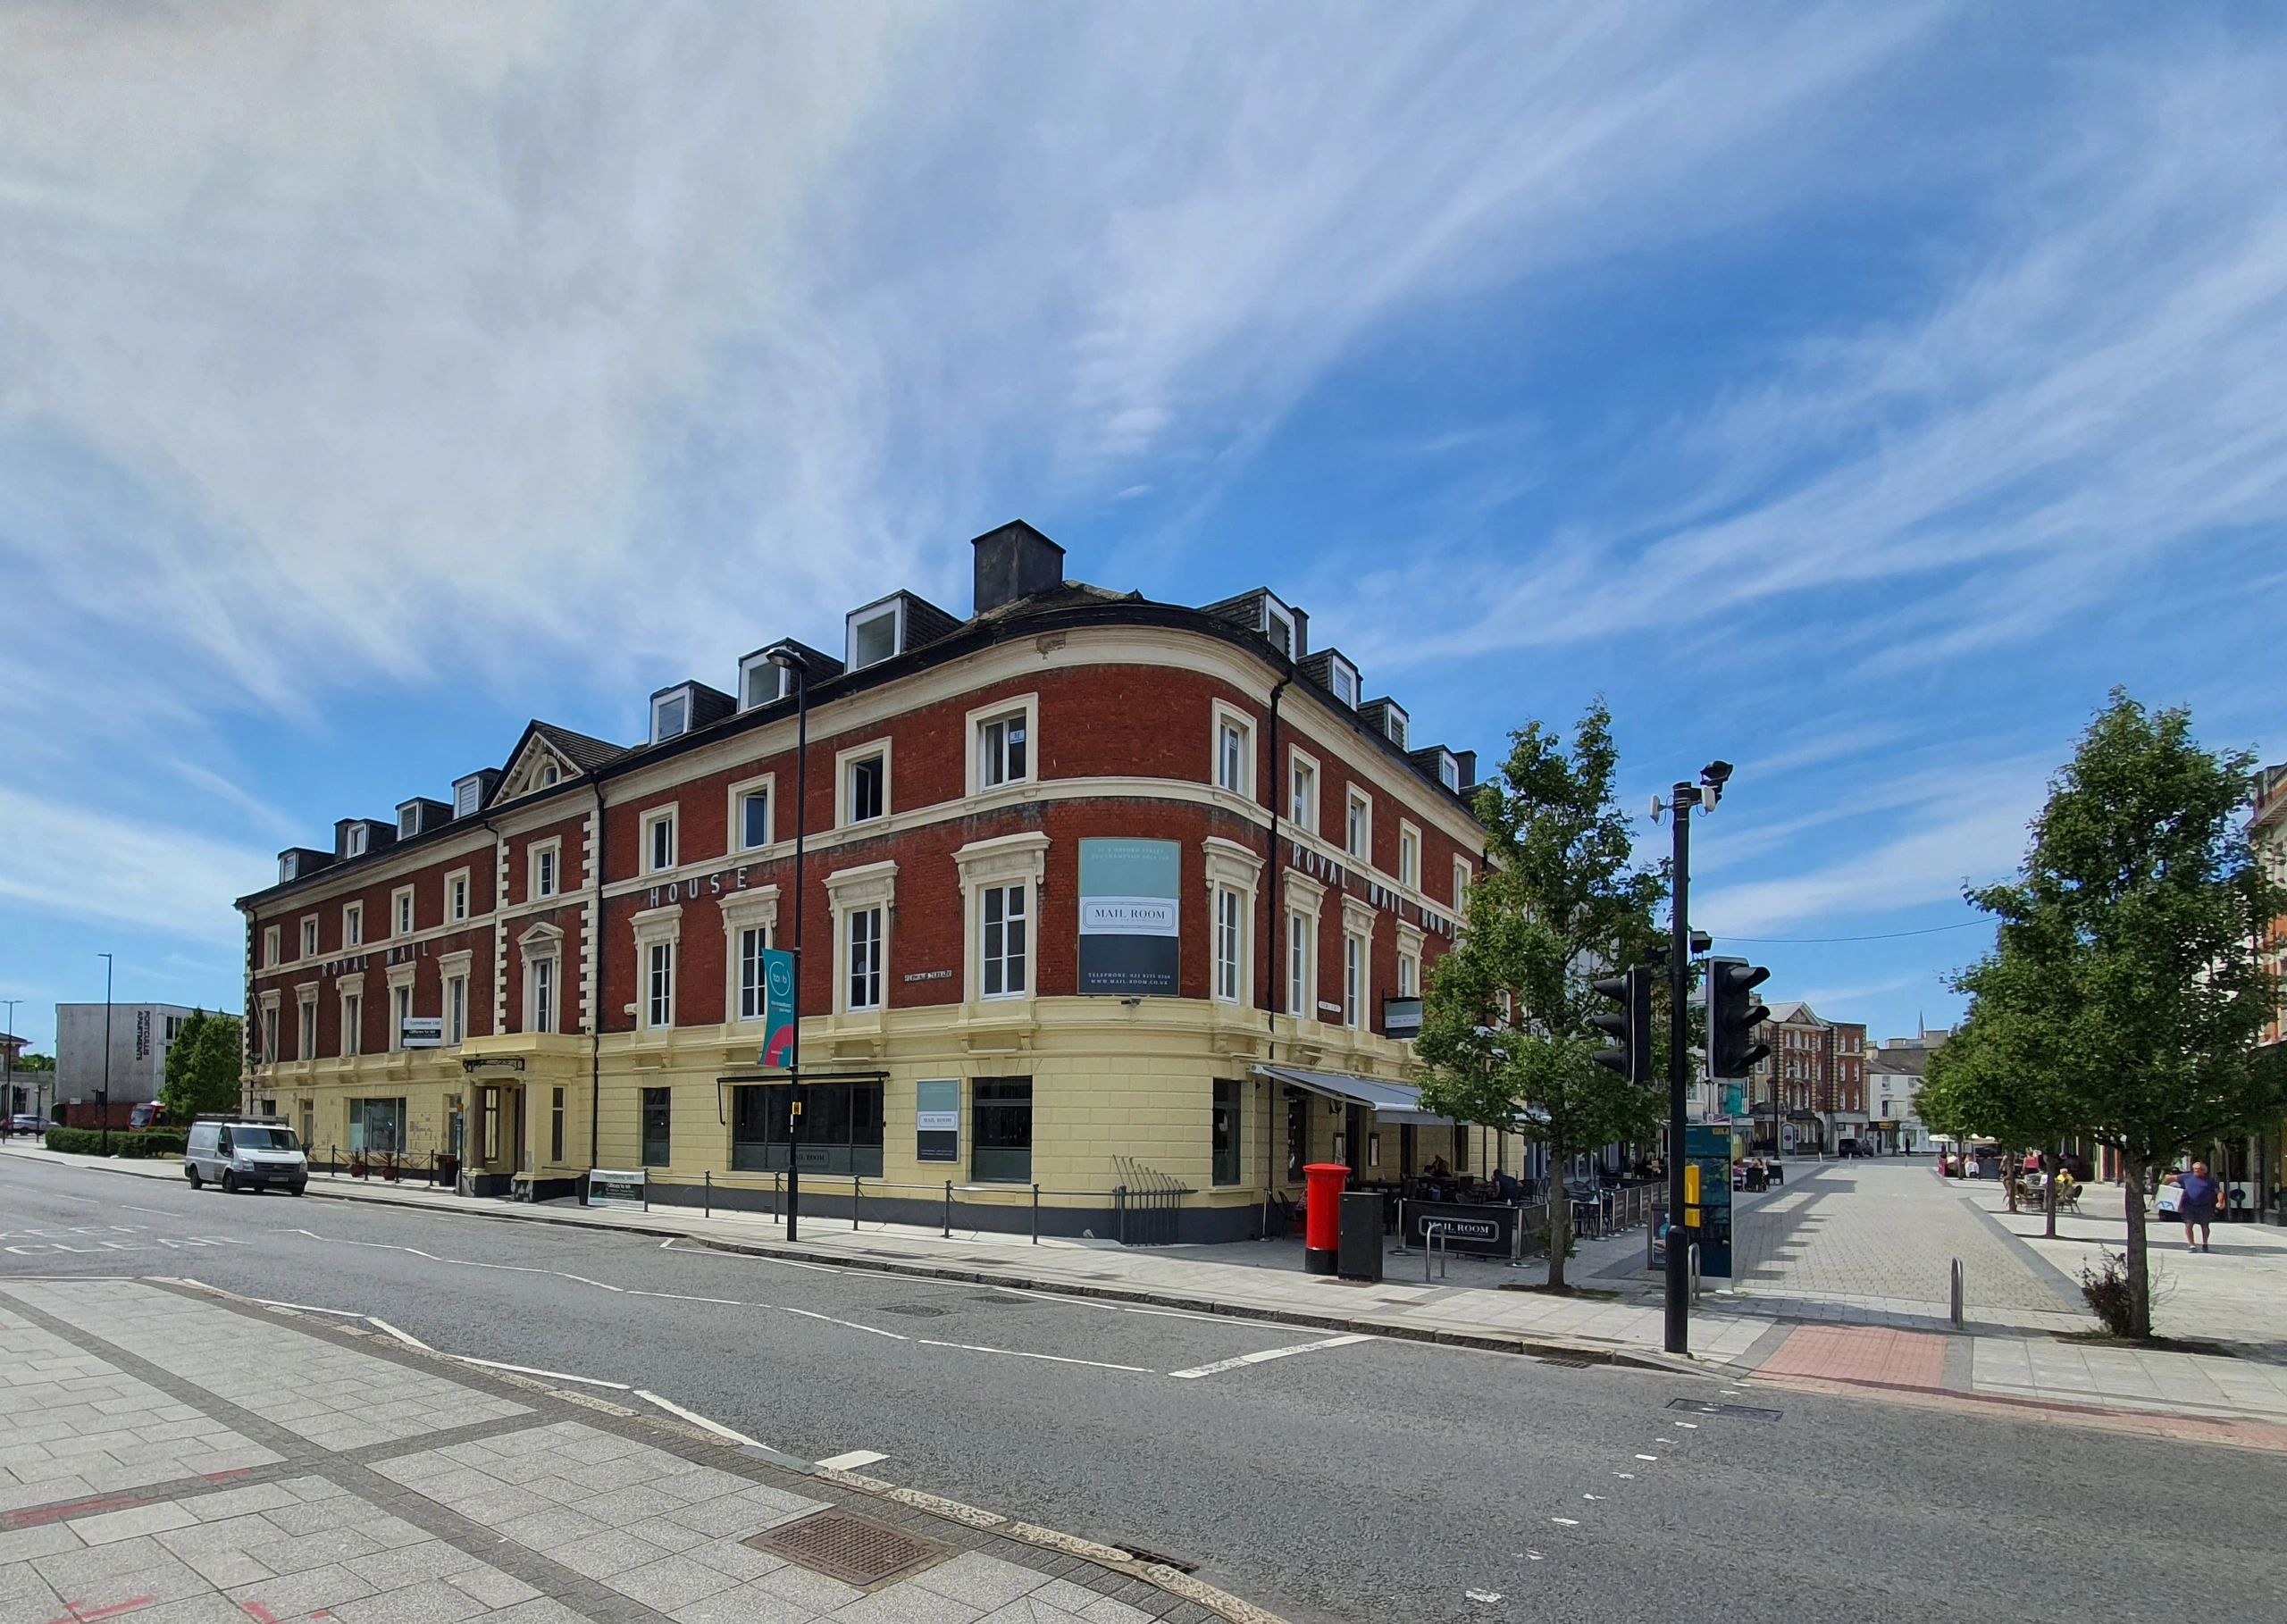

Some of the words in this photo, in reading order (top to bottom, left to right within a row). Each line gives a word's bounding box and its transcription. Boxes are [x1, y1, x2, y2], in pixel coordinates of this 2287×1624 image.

[1293, 843, 1348, 890] ROYAL
[1370, 883, 1405, 917] MAIL
[322, 955, 369, 977] ROYAL
[387, 942, 428, 966] MAIL
[649, 867, 748, 908] HOUSE
[1094, 908, 1127, 918] MAIL
[1130, 908, 1165, 919] ROOM
[1428, 1221, 1455, 1232] MIL
[1457, 1224, 1489, 1234] ROOM
[4, 1235, 254, 1255] CLEAR
